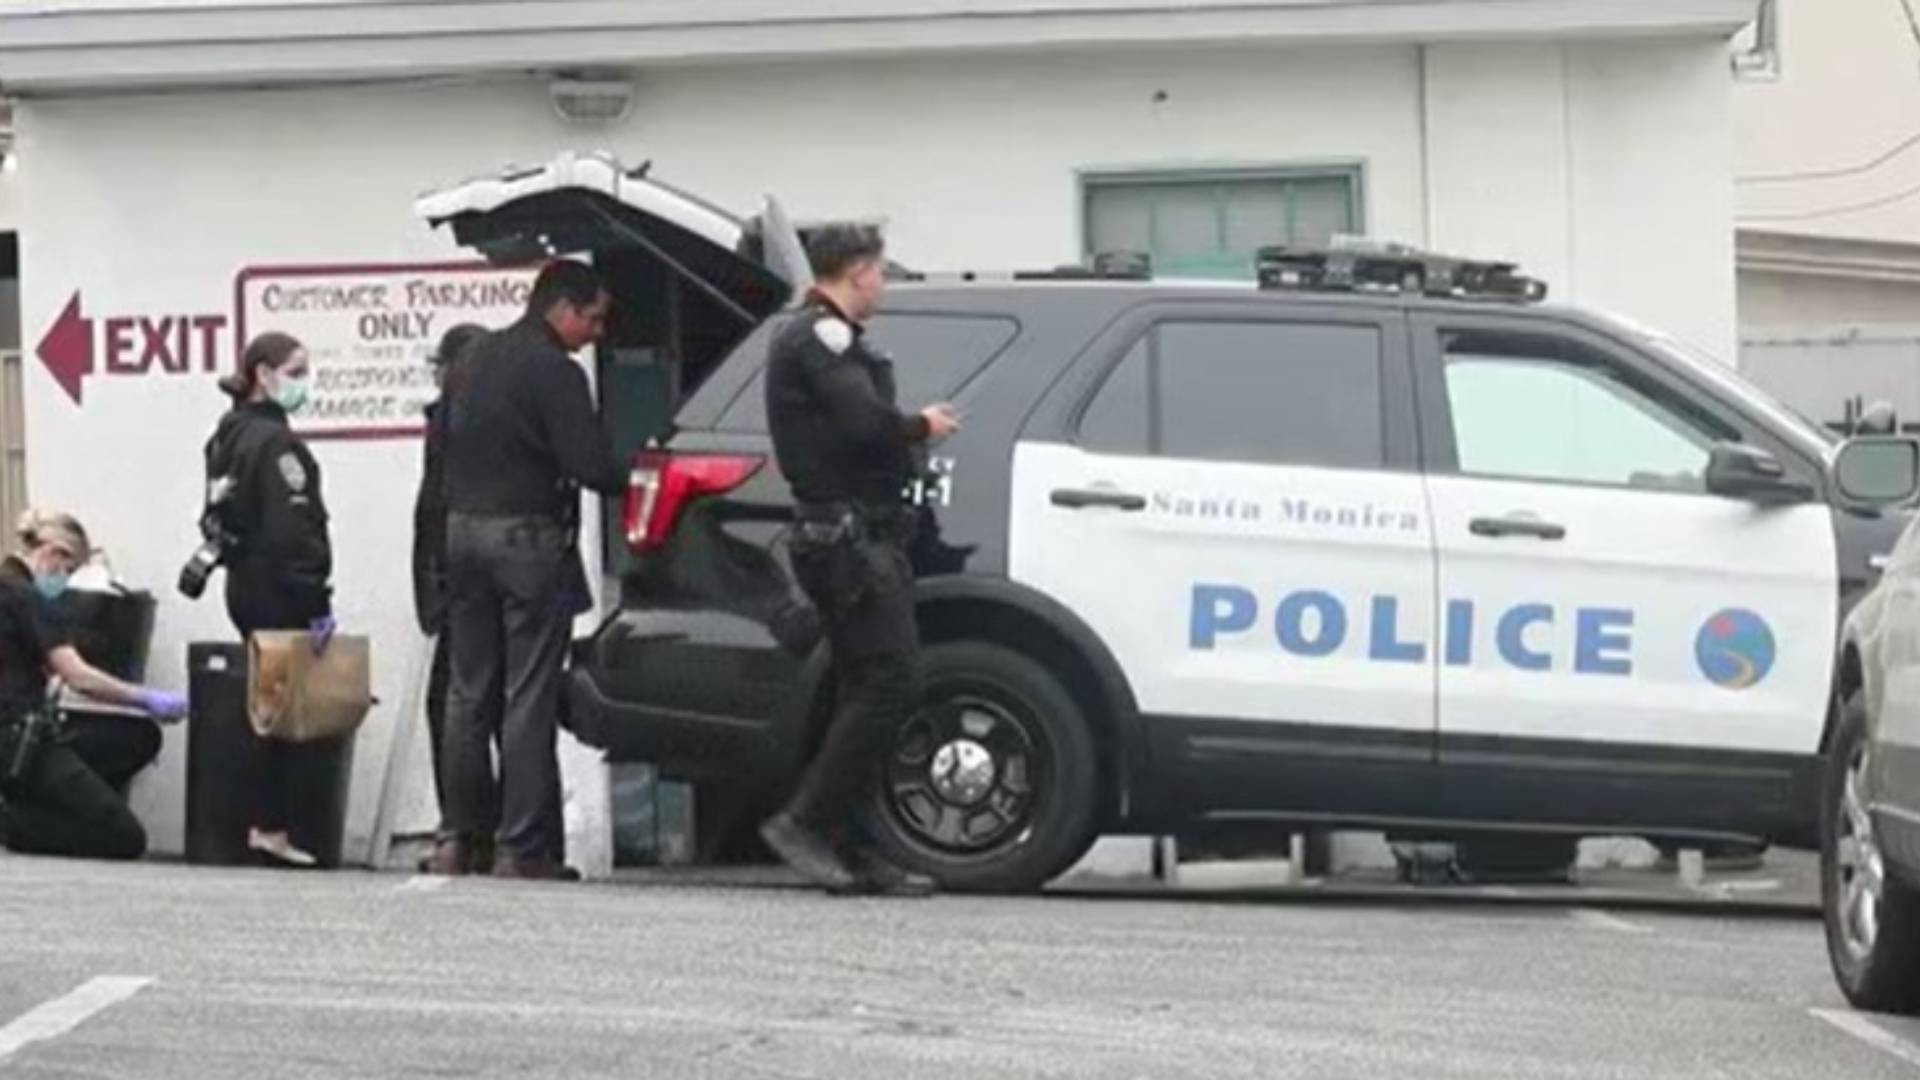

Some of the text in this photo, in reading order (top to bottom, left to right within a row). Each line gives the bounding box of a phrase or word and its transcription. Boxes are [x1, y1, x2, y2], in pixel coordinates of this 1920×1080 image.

[406, 279, 530, 309] PARKING
[105, 315, 227, 374] EXIT
[359, 312, 434, 341] ONLY
[1152, 491, 1419, 531] Santa Monica
[1189, 582, 1635, 676] POLICE
